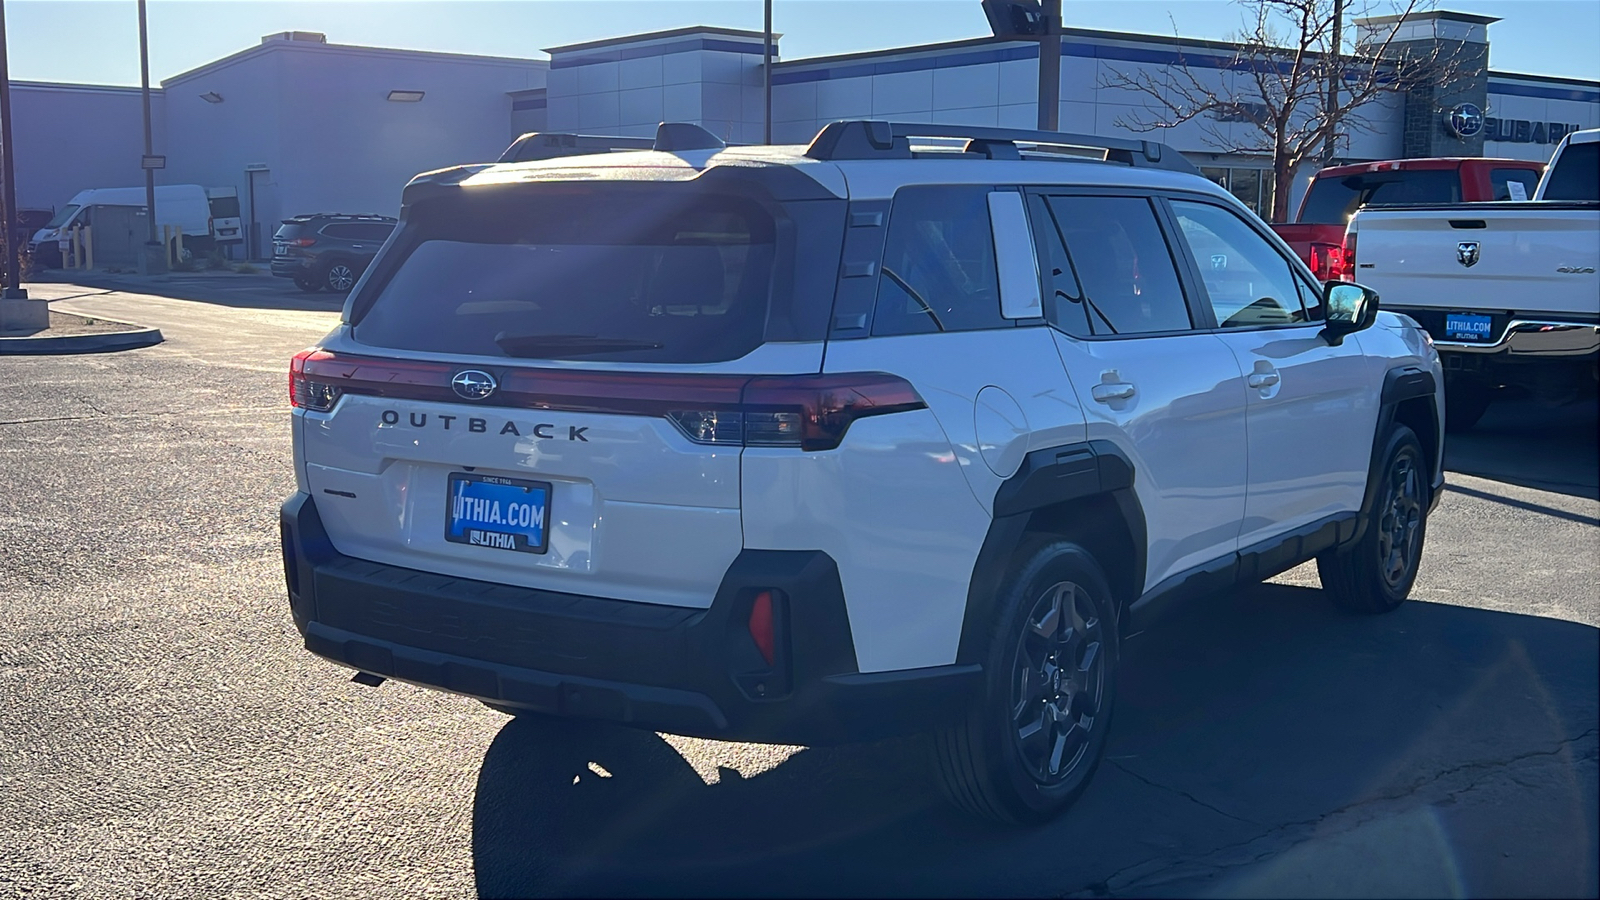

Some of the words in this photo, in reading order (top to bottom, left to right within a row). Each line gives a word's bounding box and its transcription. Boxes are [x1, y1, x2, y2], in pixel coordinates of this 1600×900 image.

[1446, 321, 1491, 332] LITHIA.COM
[381, 410, 589, 442] OUTBACK
[482, 476, 499, 484] SINCE
[452, 496, 545, 529] LITHIA.COM
[480, 531, 516, 550] LITHIA
